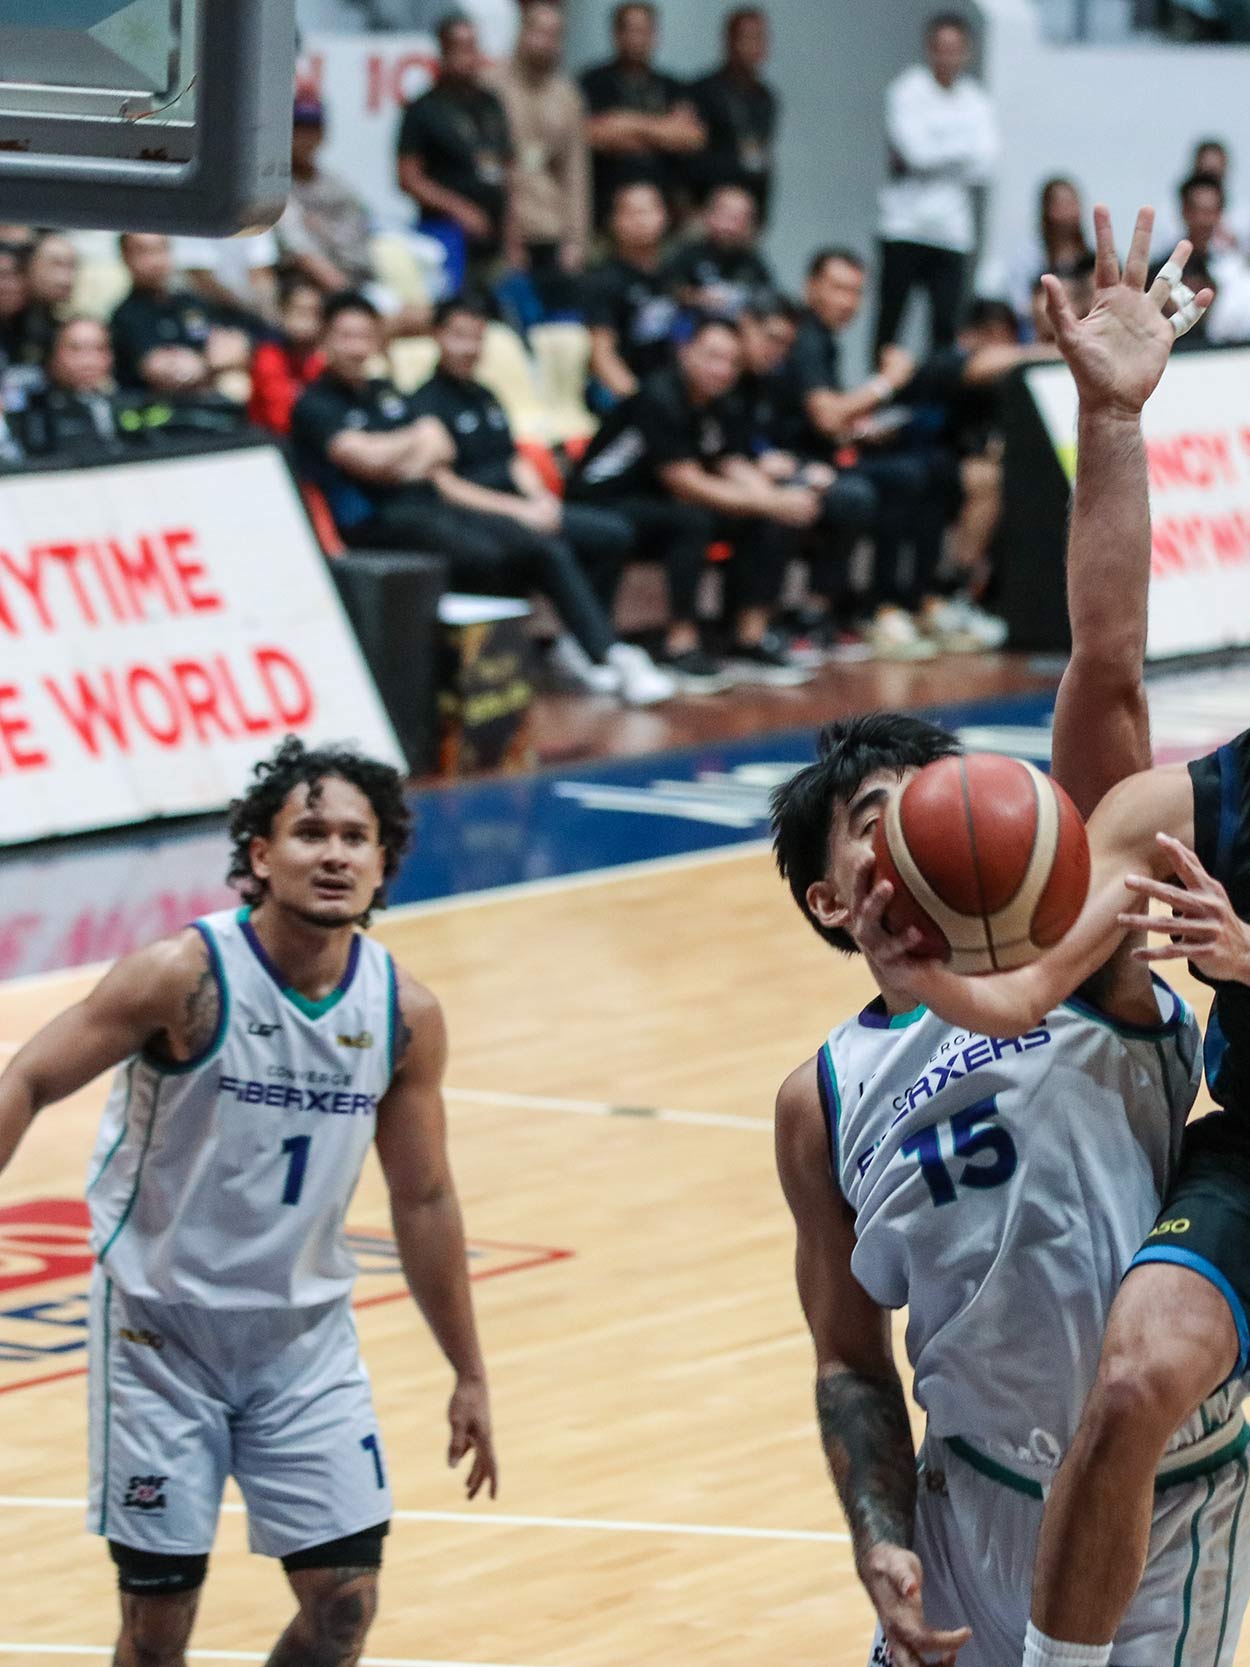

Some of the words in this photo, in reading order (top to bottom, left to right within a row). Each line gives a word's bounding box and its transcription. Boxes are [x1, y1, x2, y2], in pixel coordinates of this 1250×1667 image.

[42, 643, 316, 759] WORLD
[281, 1135, 312, 1206] 1
[900, 1093, 1018, 1207] 15
[361, 1434, 385, 1490] 1
